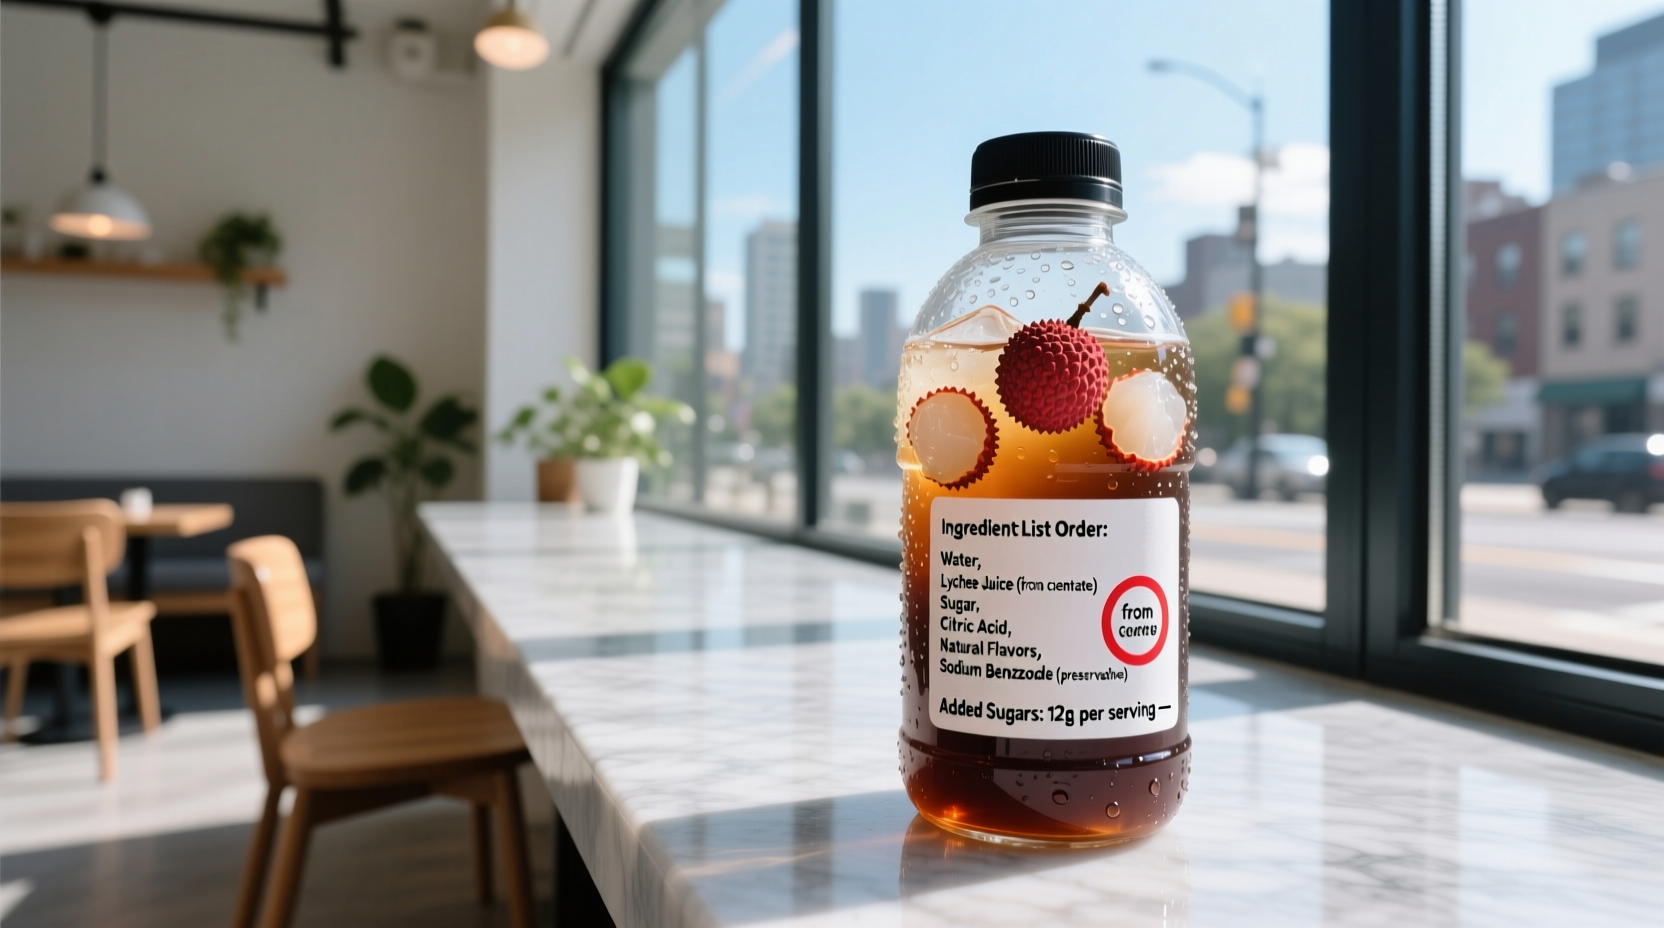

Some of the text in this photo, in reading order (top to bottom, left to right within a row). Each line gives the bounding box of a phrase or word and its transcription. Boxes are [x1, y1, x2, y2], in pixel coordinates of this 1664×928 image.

[942, 518, 1108, 540] Ingredient List Order:
[940, 551, 982, 571] Water,
[940, 573, 979, 592] Lychee
[981, 575, 1014, 591] Juice
[940, 595, 980, 615] Sugar,
[1121, 603, 1154, 620] from
[940, 616, 1012, 638] Citric Acid,
[940, 638, 1042, 661] Natural Flavors,
[939, 659, 982, 678] Sodium
[939, 697, 983, 719] Added
[986, 701, 1044, 726] Sugars:
[1047, 704, 1075, 727] 12g
[1079, 708, 1105, 727] per
[1107, 702, 1156, 722] serving
